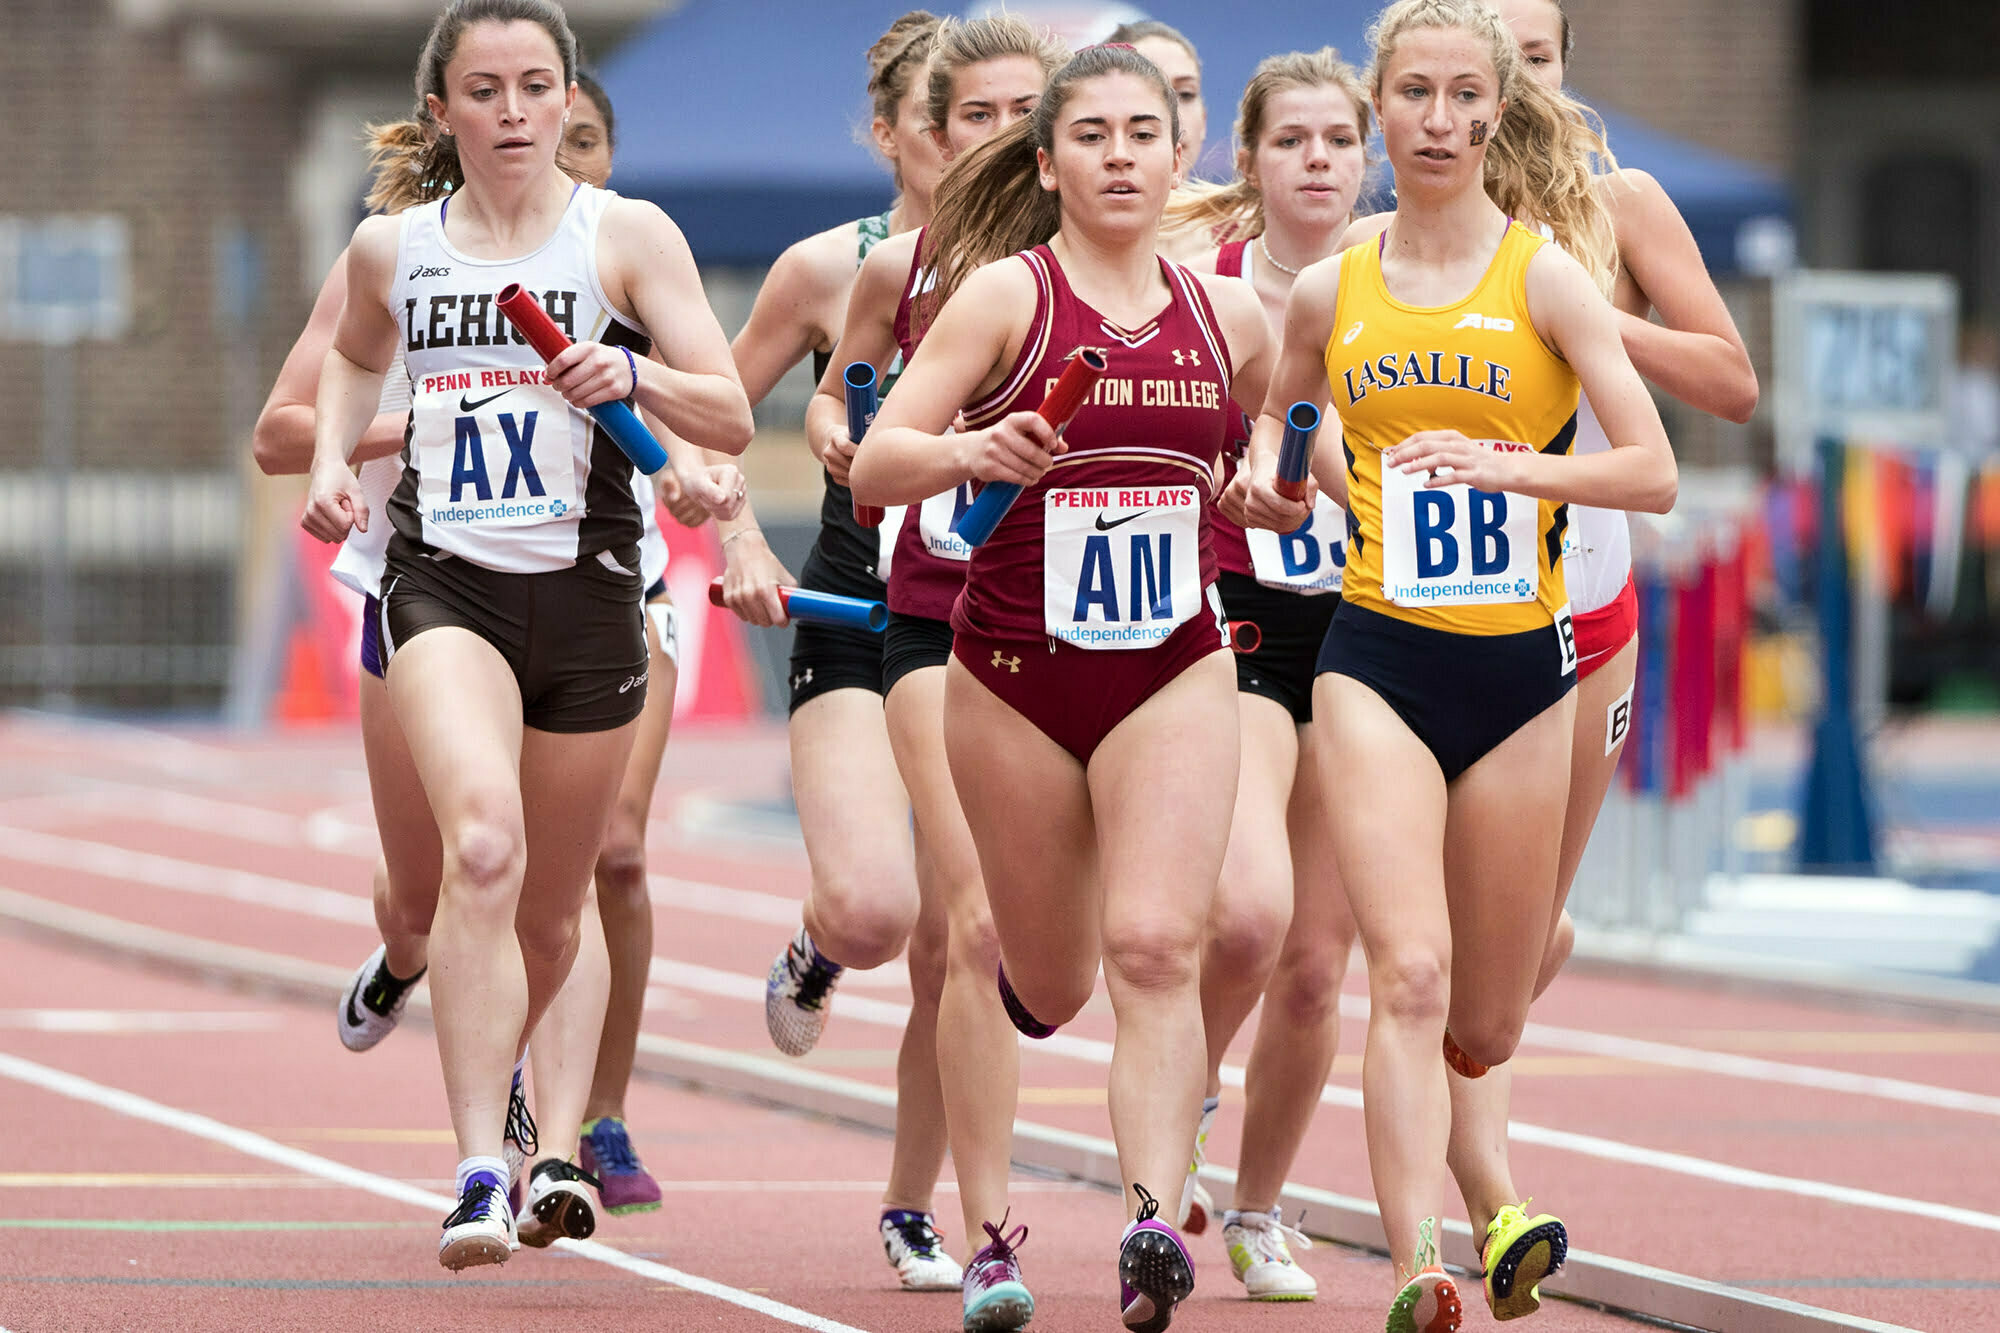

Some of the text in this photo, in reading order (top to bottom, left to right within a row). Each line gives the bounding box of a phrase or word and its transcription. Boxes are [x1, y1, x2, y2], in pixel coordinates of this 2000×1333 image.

[425, 372, 472, 393] PENN
[1141, 380, 1220, 410] COLLEGE
[449, 411, 547, 503] AX
[1054, 490, 1192, 508] PENN RELAYS
[433, 503, 545, 524] Independence
[1412, 487, 1510, 579] BB
[1072, 533, 1174, 622] AN
[1394, 581, 1511, 600] Independence
[1055, 626, 1172, 644] Independence
[1611, 700, 1629, 745] B
